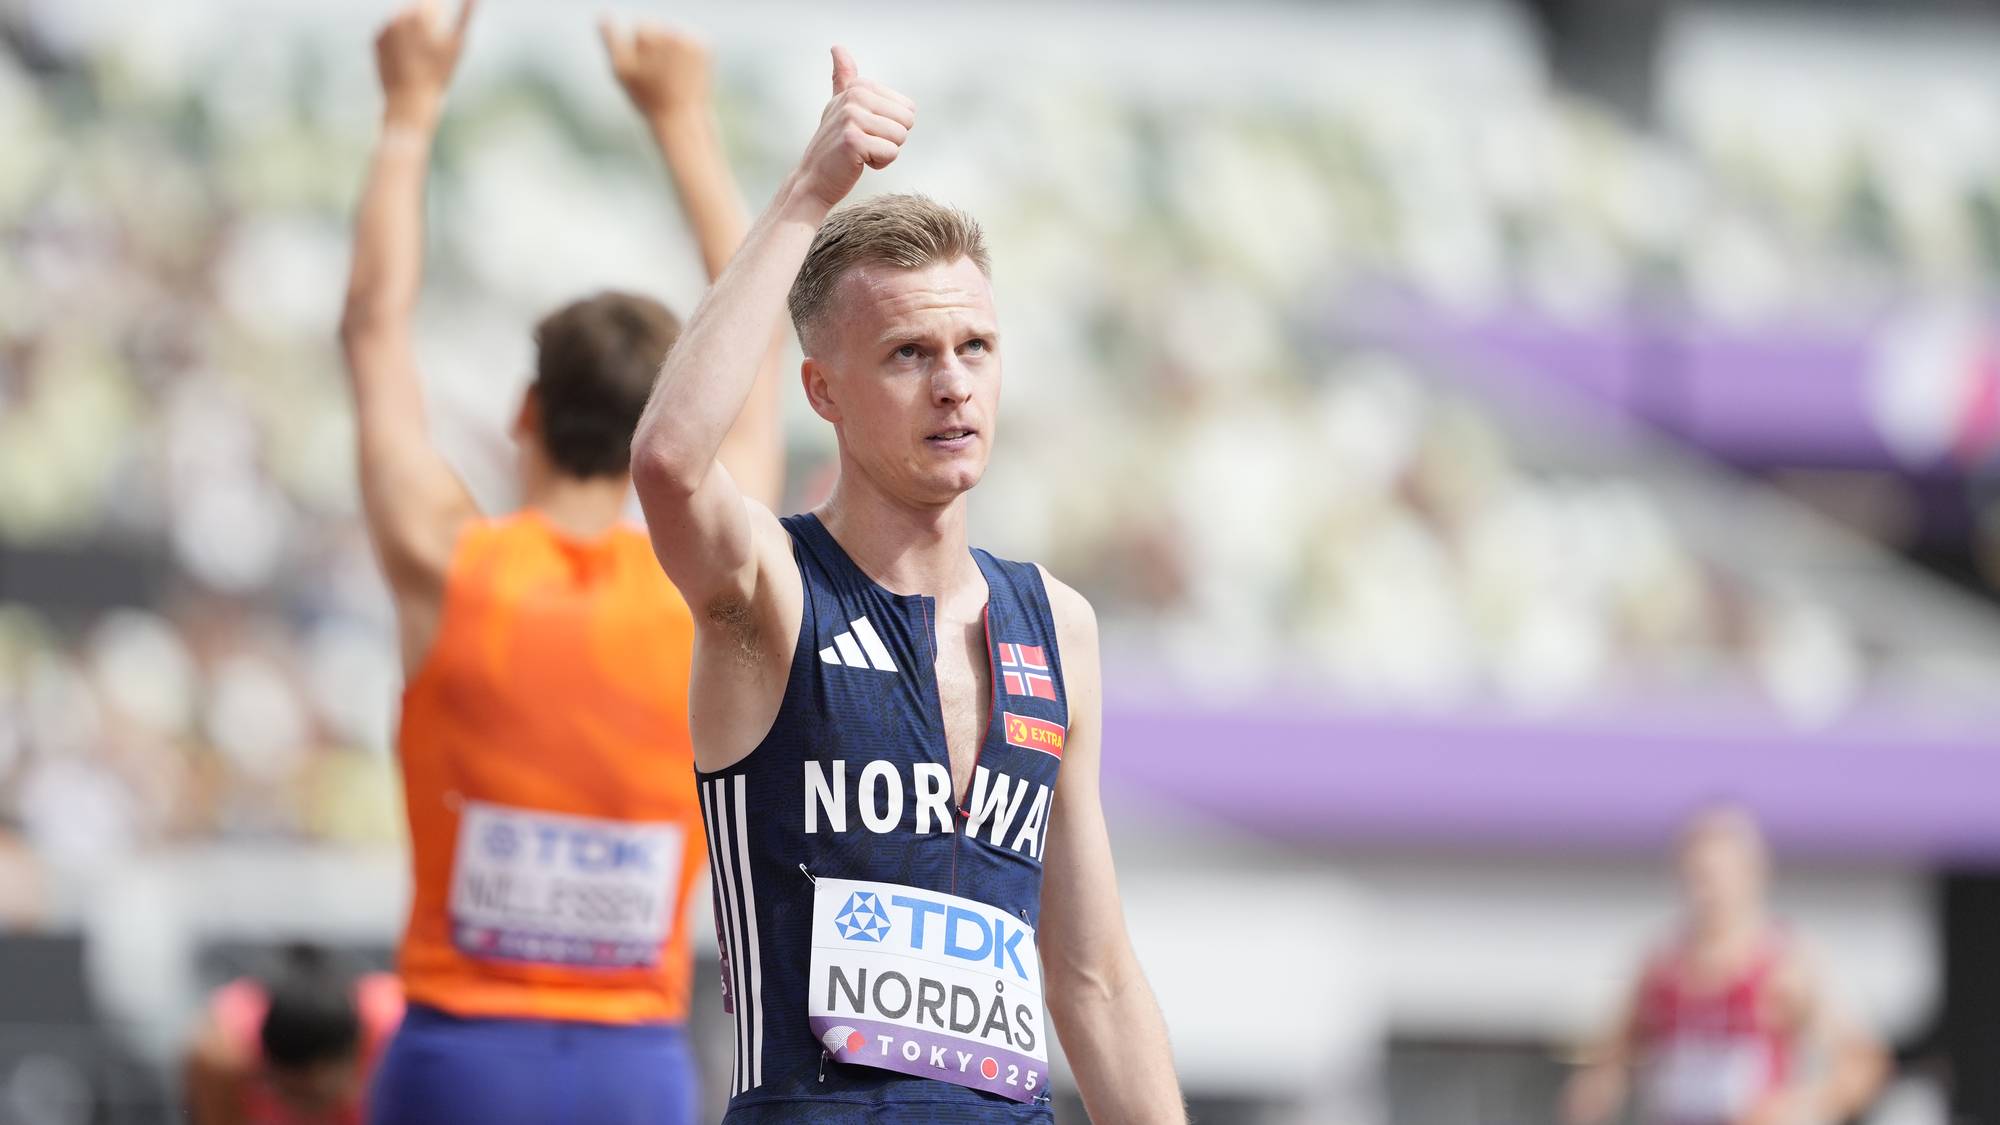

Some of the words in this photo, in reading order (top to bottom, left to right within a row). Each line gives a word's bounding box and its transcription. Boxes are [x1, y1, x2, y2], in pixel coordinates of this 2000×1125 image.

[1031, 727, 1062, 749] EXTRA
[536, 827, 652, 873] TDK
[804, 759, 1054, 862] NORWA
[892, 895, 1028, 981] TDK
[827, 965, 1036, 1052] NORDÅS
